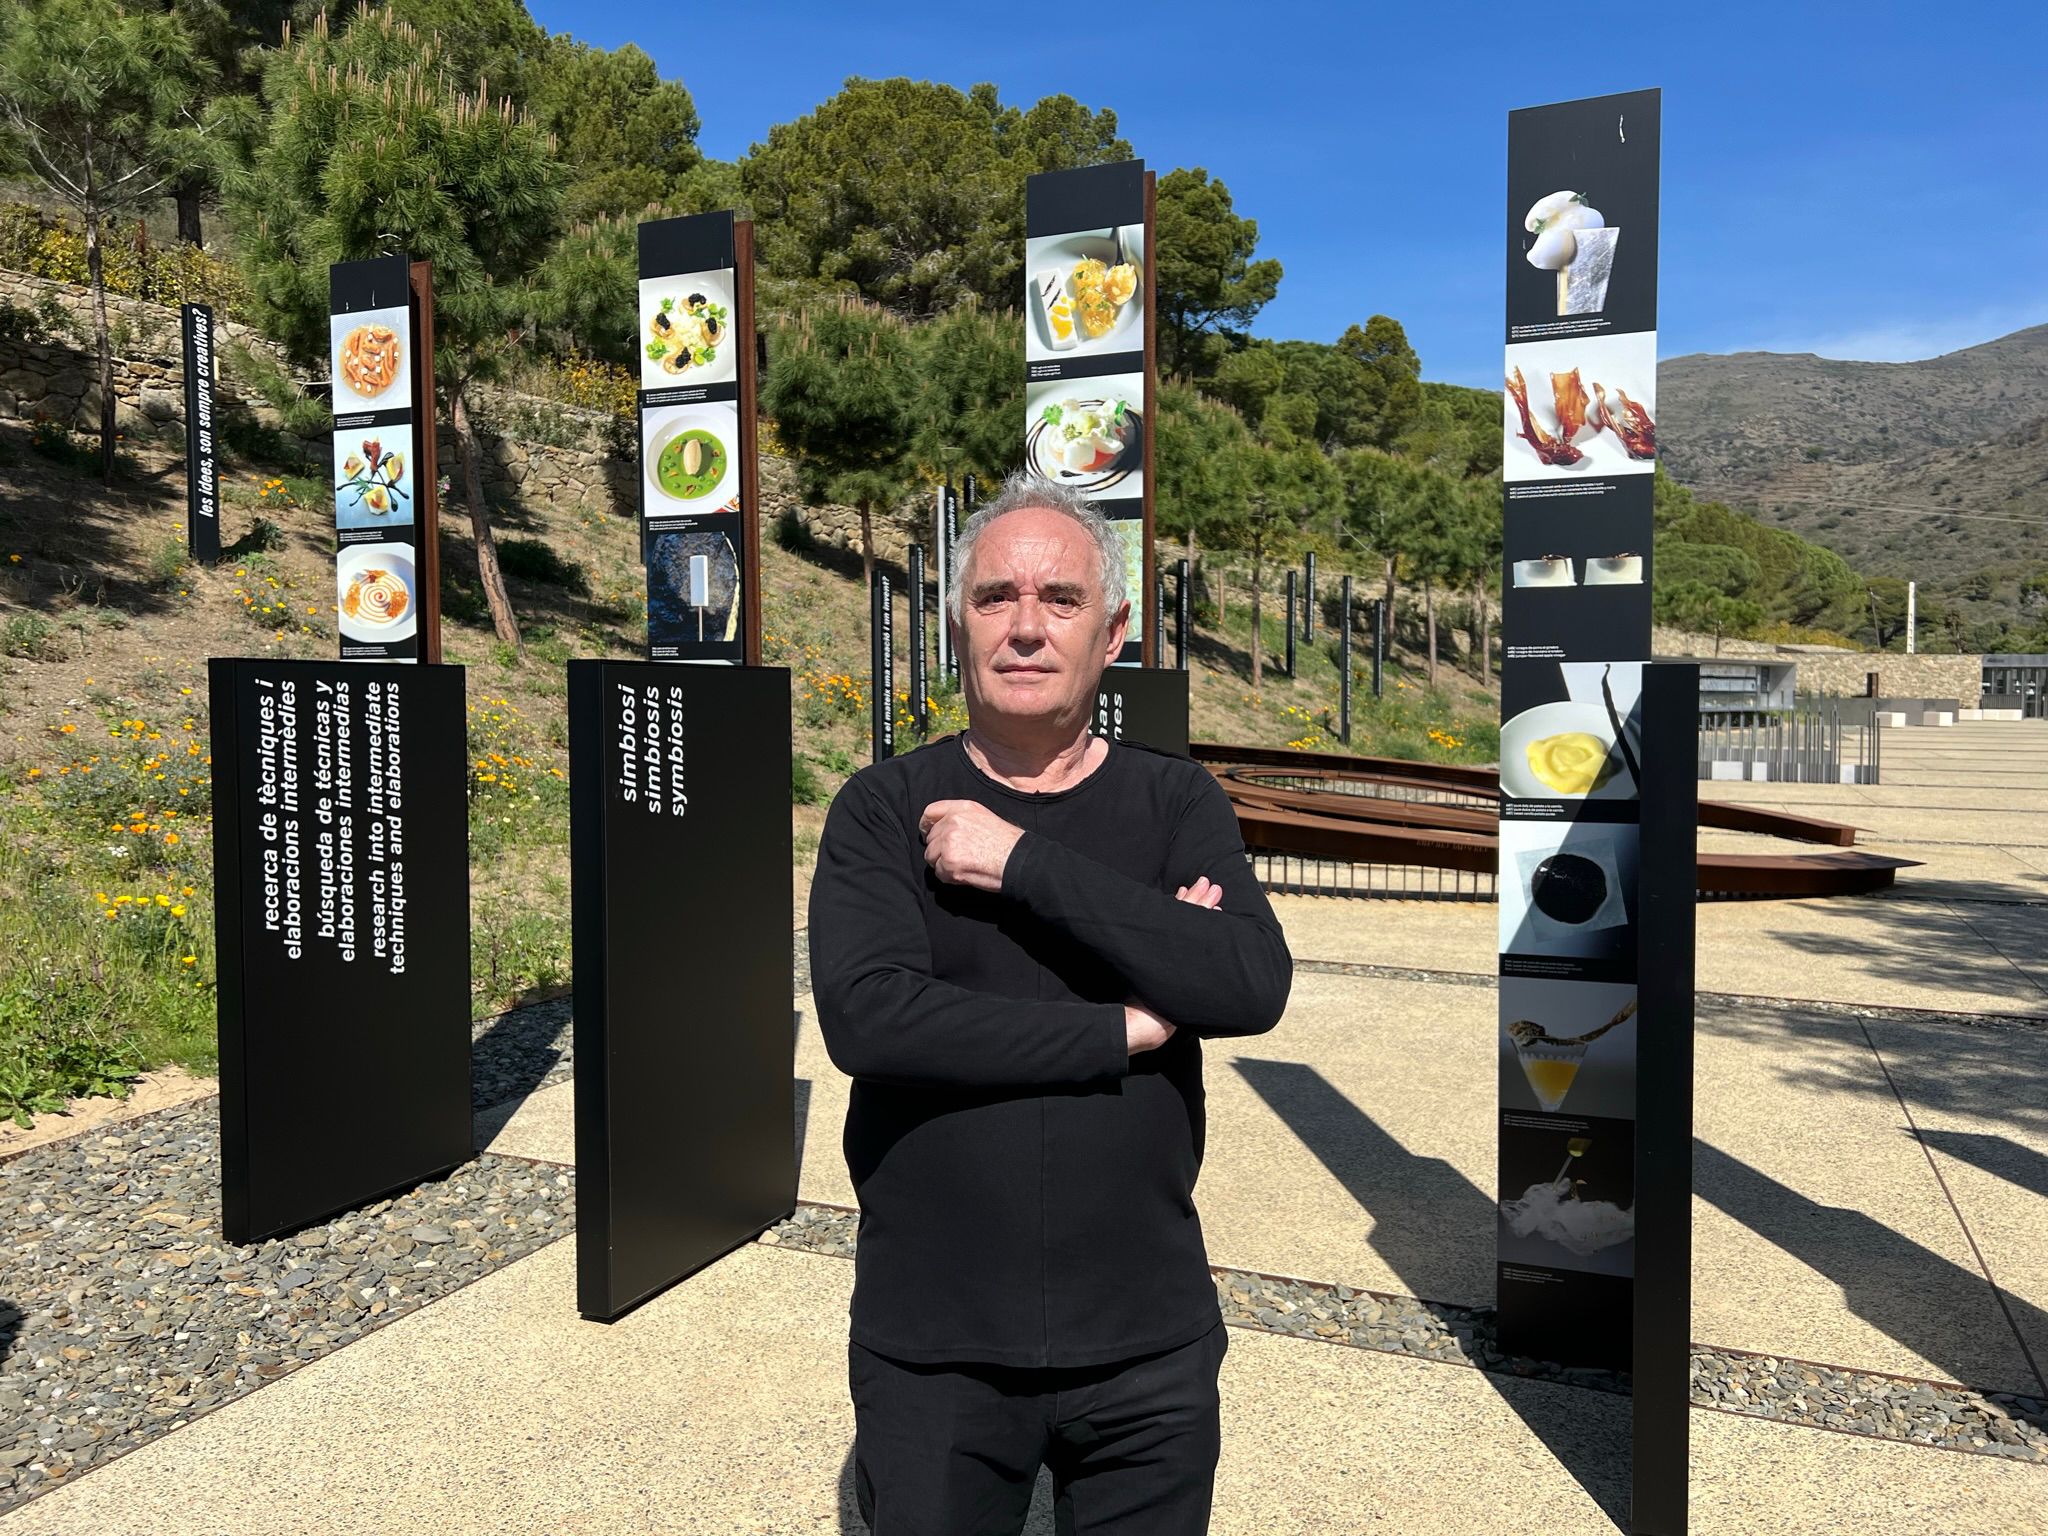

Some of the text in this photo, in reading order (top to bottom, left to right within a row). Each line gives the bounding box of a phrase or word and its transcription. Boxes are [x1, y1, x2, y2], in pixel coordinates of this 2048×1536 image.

[192, 308, 214, 518] les idees, son sempre creatives?
[882, 576, 891, 611] invent?
[883, 633, 892, 667] creació
[255, 679, 282, 930] recerca de tècniques i
[314, 680, 337, 937] búsqueda de técnicas y
[618, 684, 636, 802] simbiosi
[643, 686, 661, 813] simbiosis
[667, 686, 687, 816] symbiosis
[883, 689, 892, 720] mateix
[278, 681, 301, 959] elaboracions intermèdies
[333, 682, 355, 961] elaboraciones intermedias
[365, 682, 386, 957] research into intermediate
[384, 683, 406, 974] techniques and elaborations
